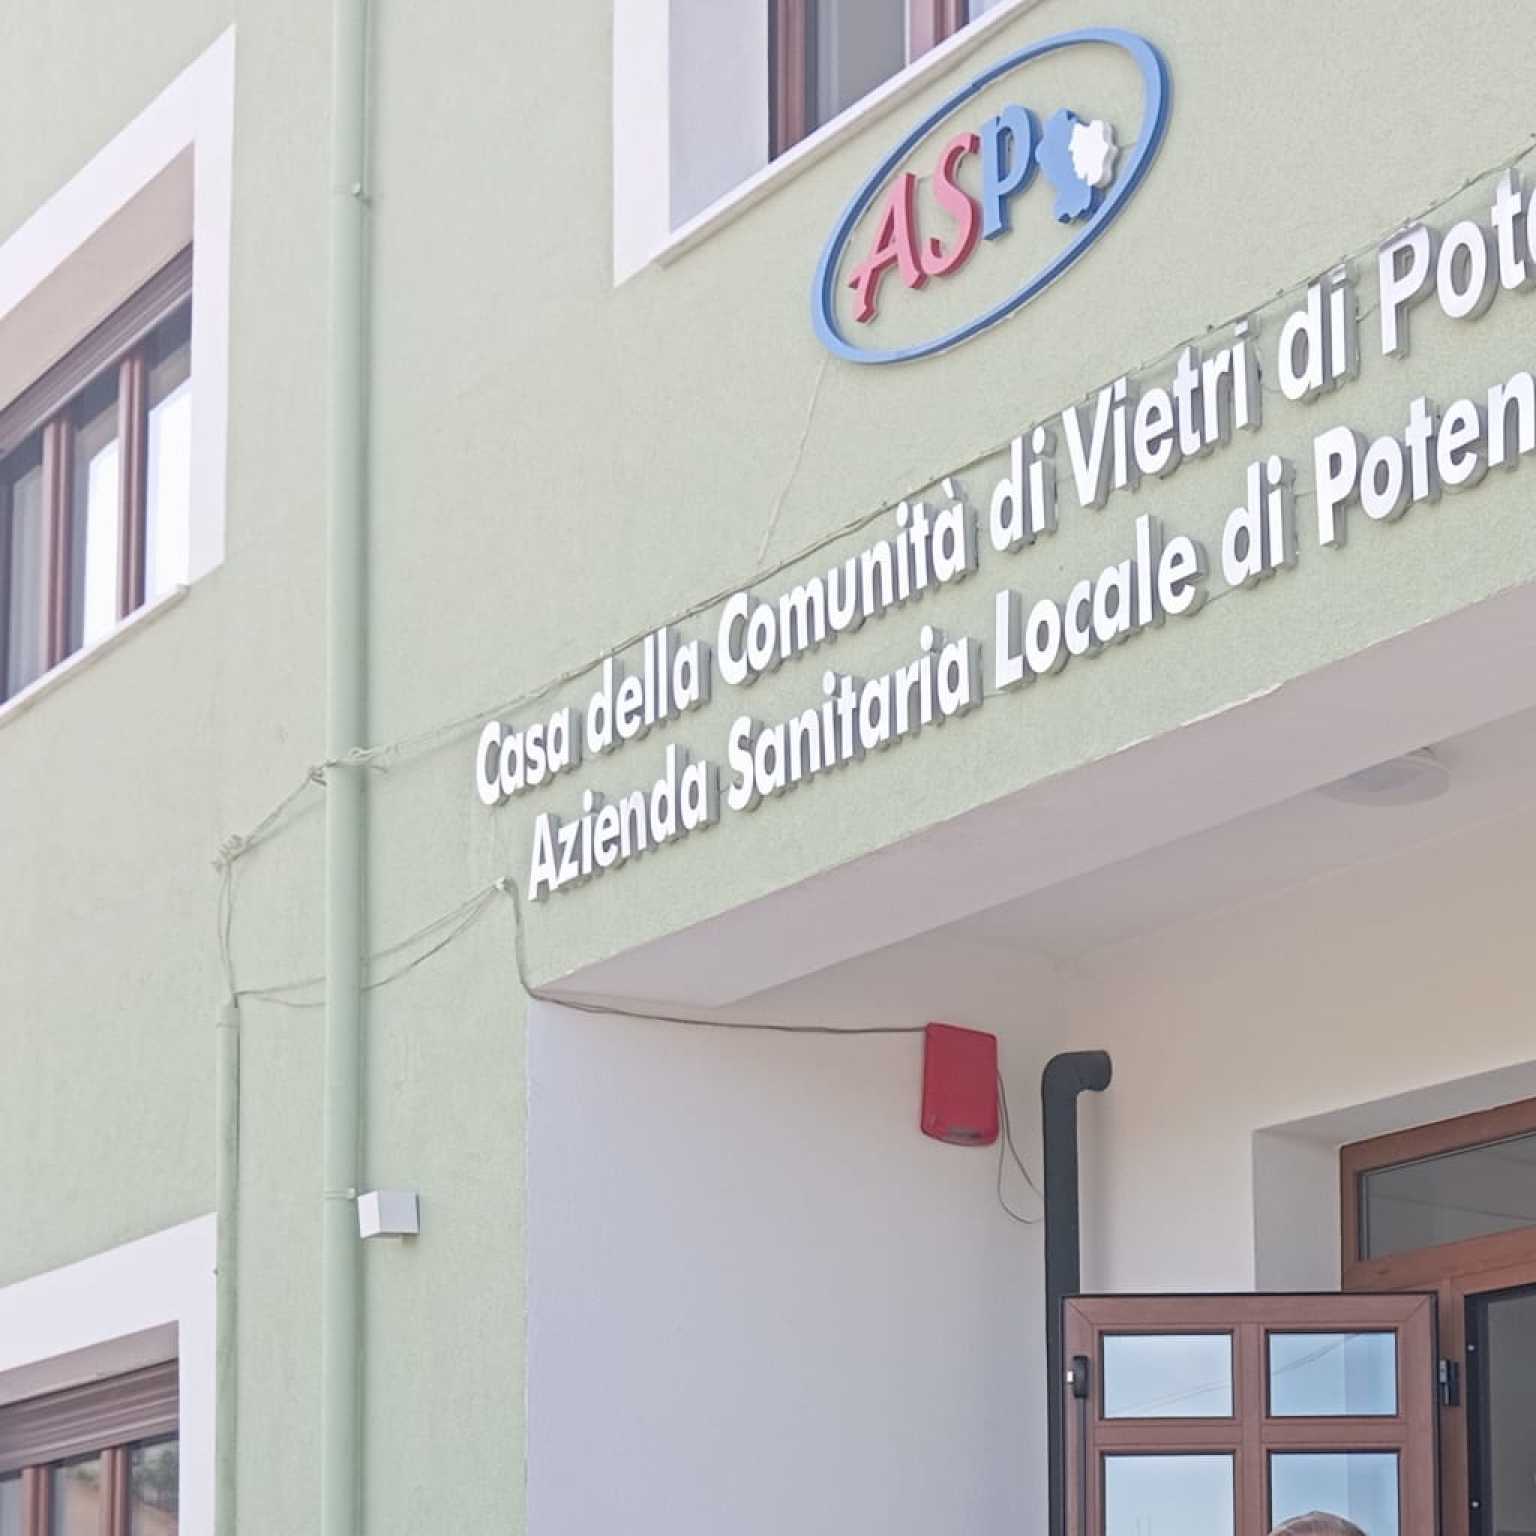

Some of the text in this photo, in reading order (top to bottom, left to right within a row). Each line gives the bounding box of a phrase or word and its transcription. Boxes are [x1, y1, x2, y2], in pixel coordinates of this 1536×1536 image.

[849, 105, 1036, 324] ASP
[476, 707, 571, 806] Casa
[587, 624, 704, 756] della
[717, 478, 968, 686] Comunità
[990, 427, 1052, 552] di
[1063, 322, 1249, 508] Vietri
[1278, 264, 1347, 400] di
[528, 743, 709, 902] Azienda
[727, 625, 973, 811] Sanitaria
[996, 513, 1199, 691] Locale
[1222, 454, 1283, 587] di
